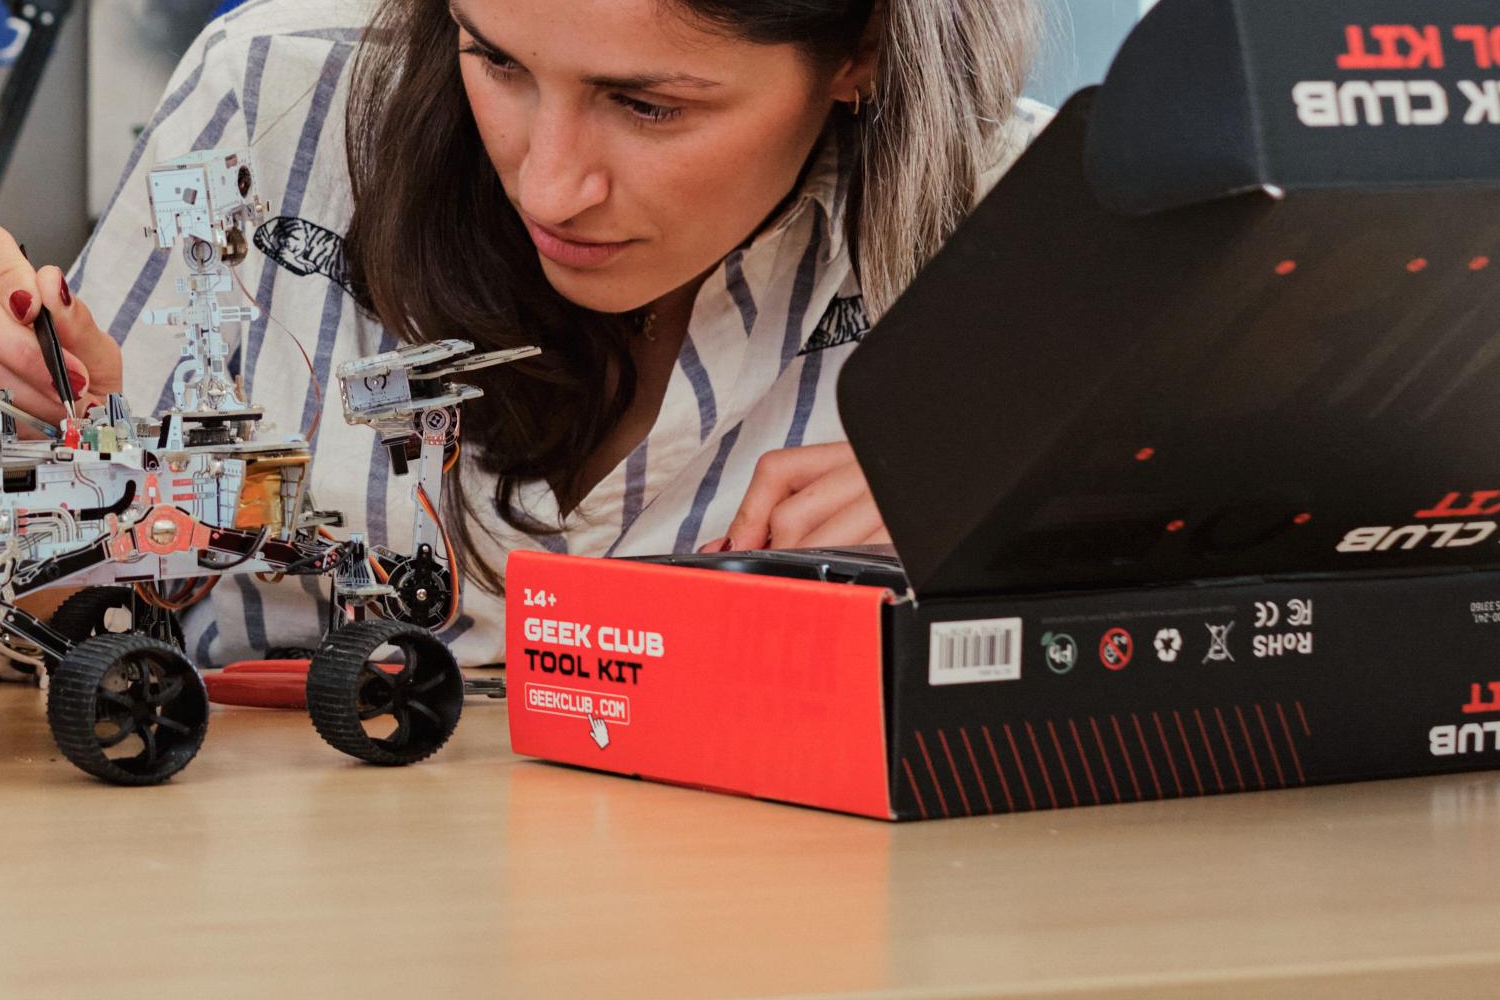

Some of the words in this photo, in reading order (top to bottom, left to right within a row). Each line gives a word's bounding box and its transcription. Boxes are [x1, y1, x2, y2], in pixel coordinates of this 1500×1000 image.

[1336, 24, 1445, 69] KIT
[1292, 80, 1449, 127] CLUB
[1335, 520, 1497, 553] CLUB
[523, 588, 557, 607] 14+
[1253, 600, 1280, 628] CE
[524, 617, 592, 648] GEEK
[598, 626, 665, 657] CLUB
[1252, 631, 1312, 658] RoHS
[524, 648, 590, 679] TOOL
[598, 657, 643, 685] KIT
[529, 689, 626, 719] GEEKCLUB.COM
